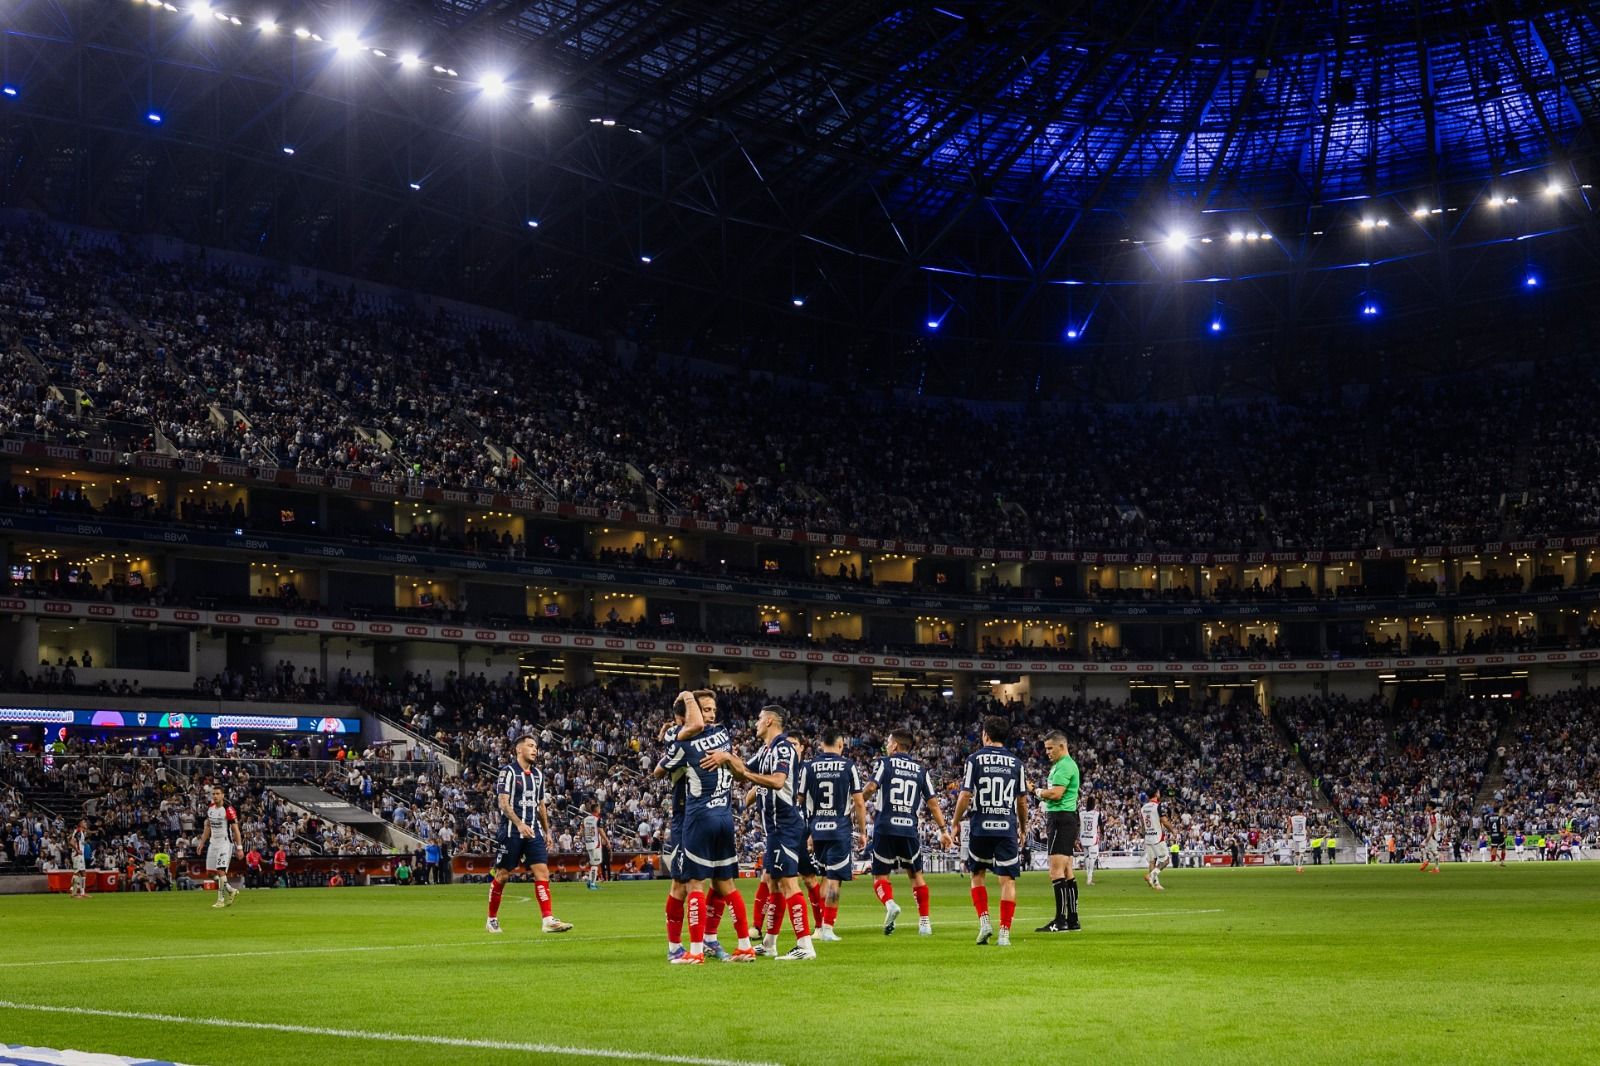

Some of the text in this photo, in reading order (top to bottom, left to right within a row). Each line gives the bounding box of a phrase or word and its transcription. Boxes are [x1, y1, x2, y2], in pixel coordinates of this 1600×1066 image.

[47, 446, 79, 459] TECATE
[142, 457, 172, 469] TECATE
[218, 464, 246, 476] TECATE
[296, 474, 324, 486] TECATE
[370, 484, 398, 494] TECATE
[442, 490, 468, 501] TECATE
[511, 500, 536, 510] TECATE
[576, 506, 599, 516] TECATE
[636, 513, 659, 524] TECATE
[696, 520, 718, 529] TECATE
[78, 525, 104, 535] BBVA
[752, 526, 774, 536] TECATE
[164, 532, 189, 542] BBVA
[807, 533, 827, 542] TECATE
[245, 540, 269, 549] BBVA
[323, 546, 344, 556] BBVA
[397, 554, 418, 563] BBVA
[467, 560, 487, 568] BBVA
[534, 568, 552, 576] BBVA
[690, 728, 730, 752] TECATE
[890, 758, 920, 772] TECATE
[976, 754, 1015, 767] TECATE
[811, 761, 846, 772] TECATE
[819, 781, 833, 809] 3
[890, 778, 917, 806] 20
[979, 777, 1015, 808] 204
[774, 850, 780, 862] 7
[108, 875, 115, 885] G
